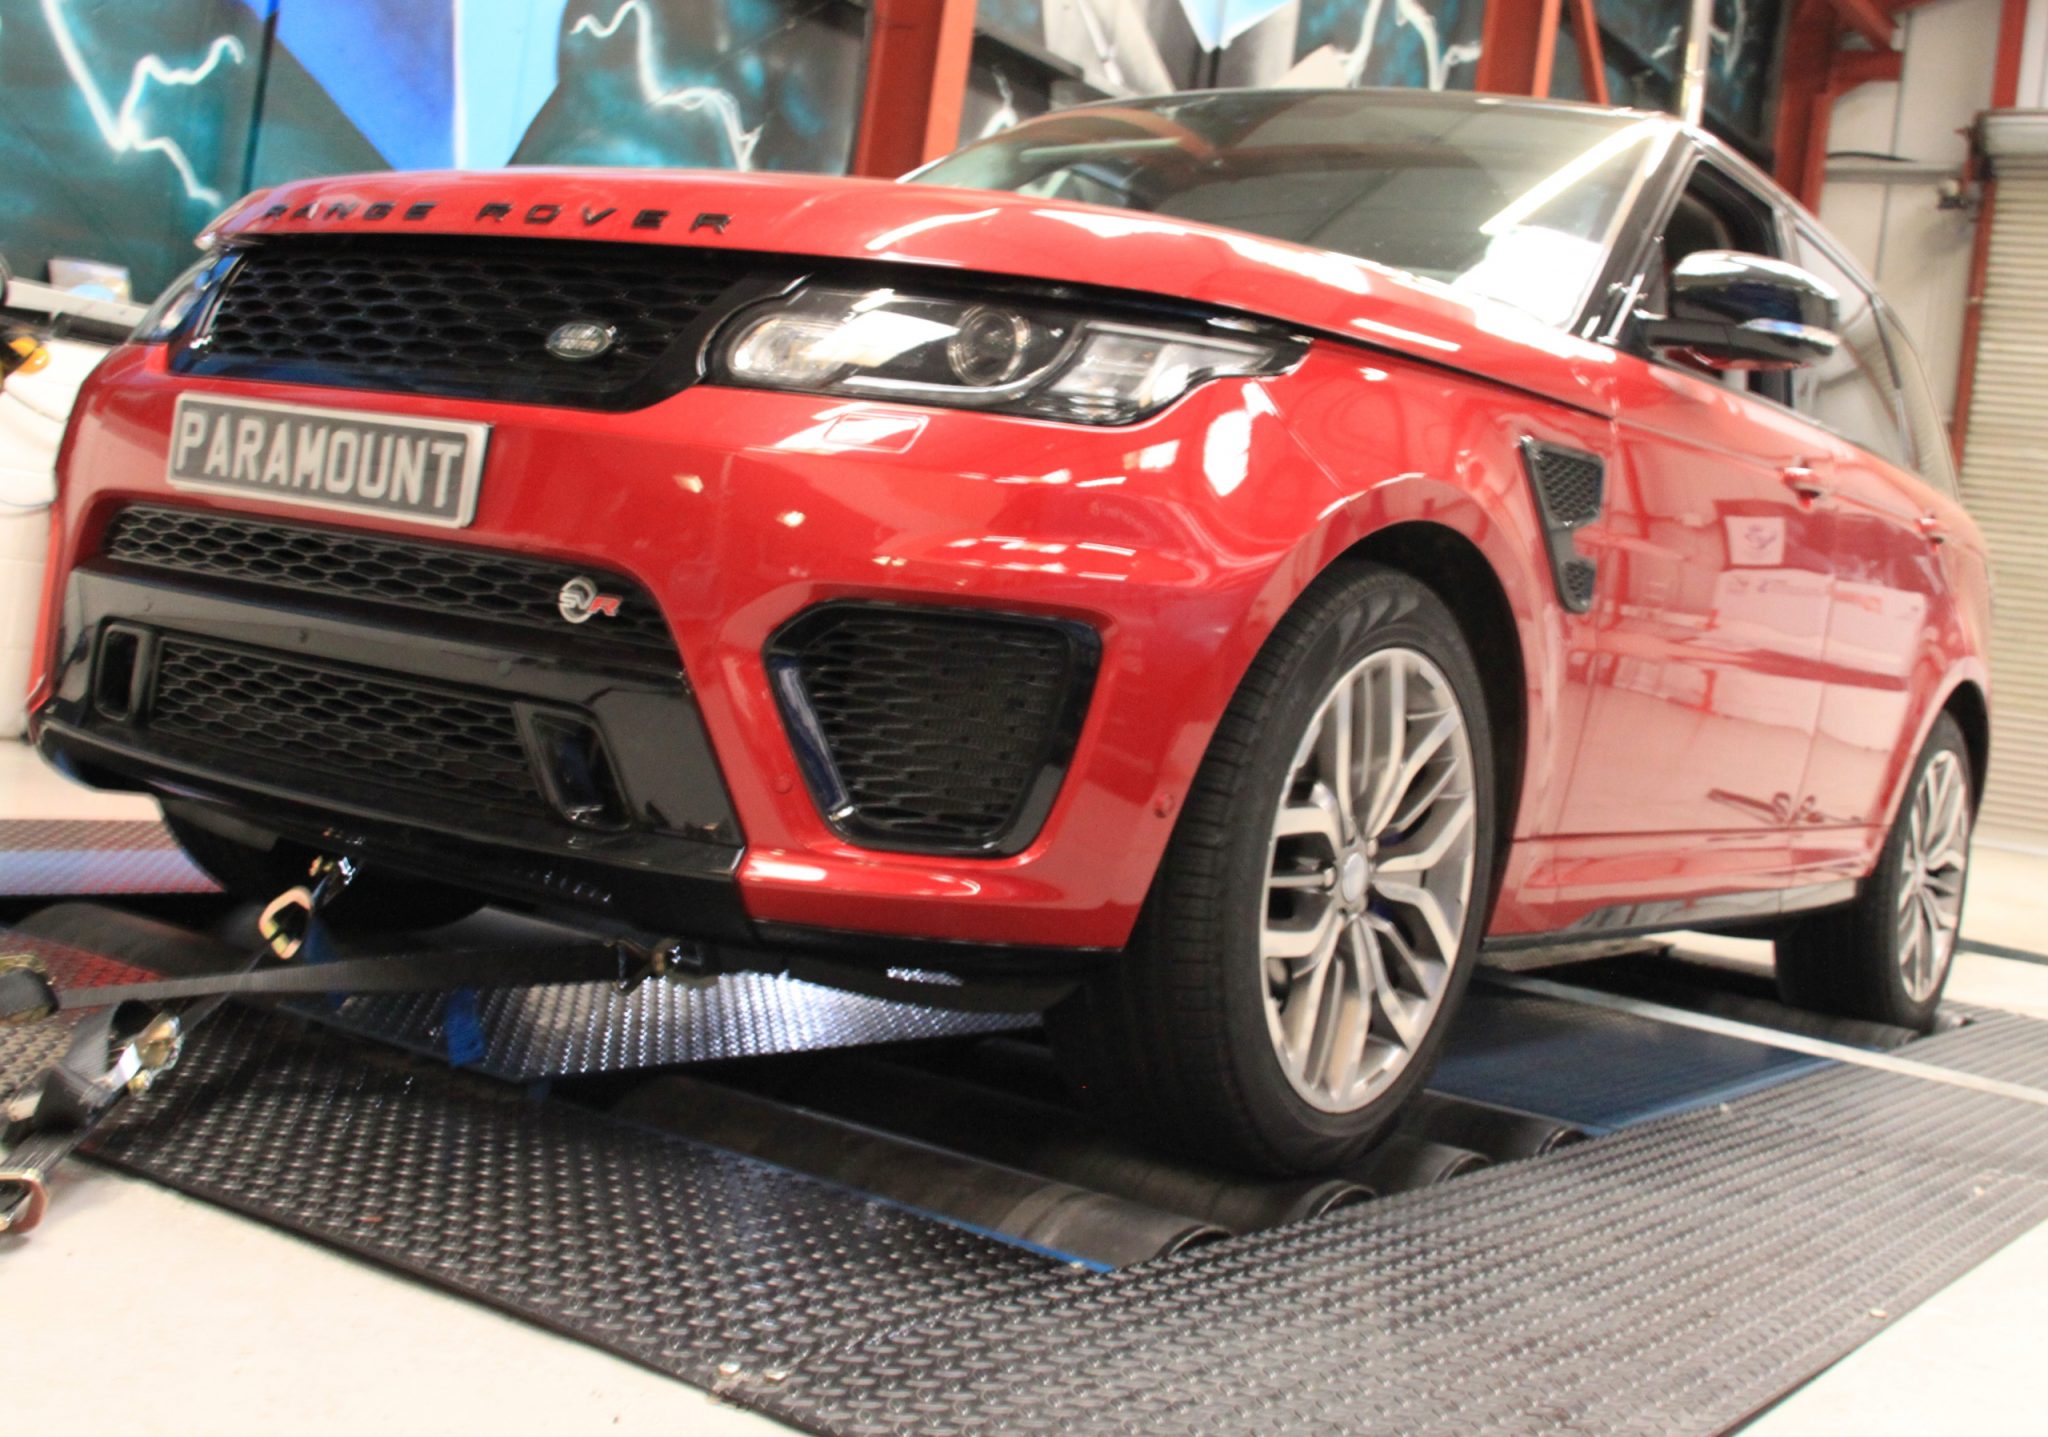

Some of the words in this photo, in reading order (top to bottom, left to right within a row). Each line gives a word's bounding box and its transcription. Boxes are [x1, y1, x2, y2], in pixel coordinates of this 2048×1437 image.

[264, 202, 436, 221] RANGE
[475, 203, 735, 235] ROVER
[174, 409, 463, 509] PARAMOUNT
